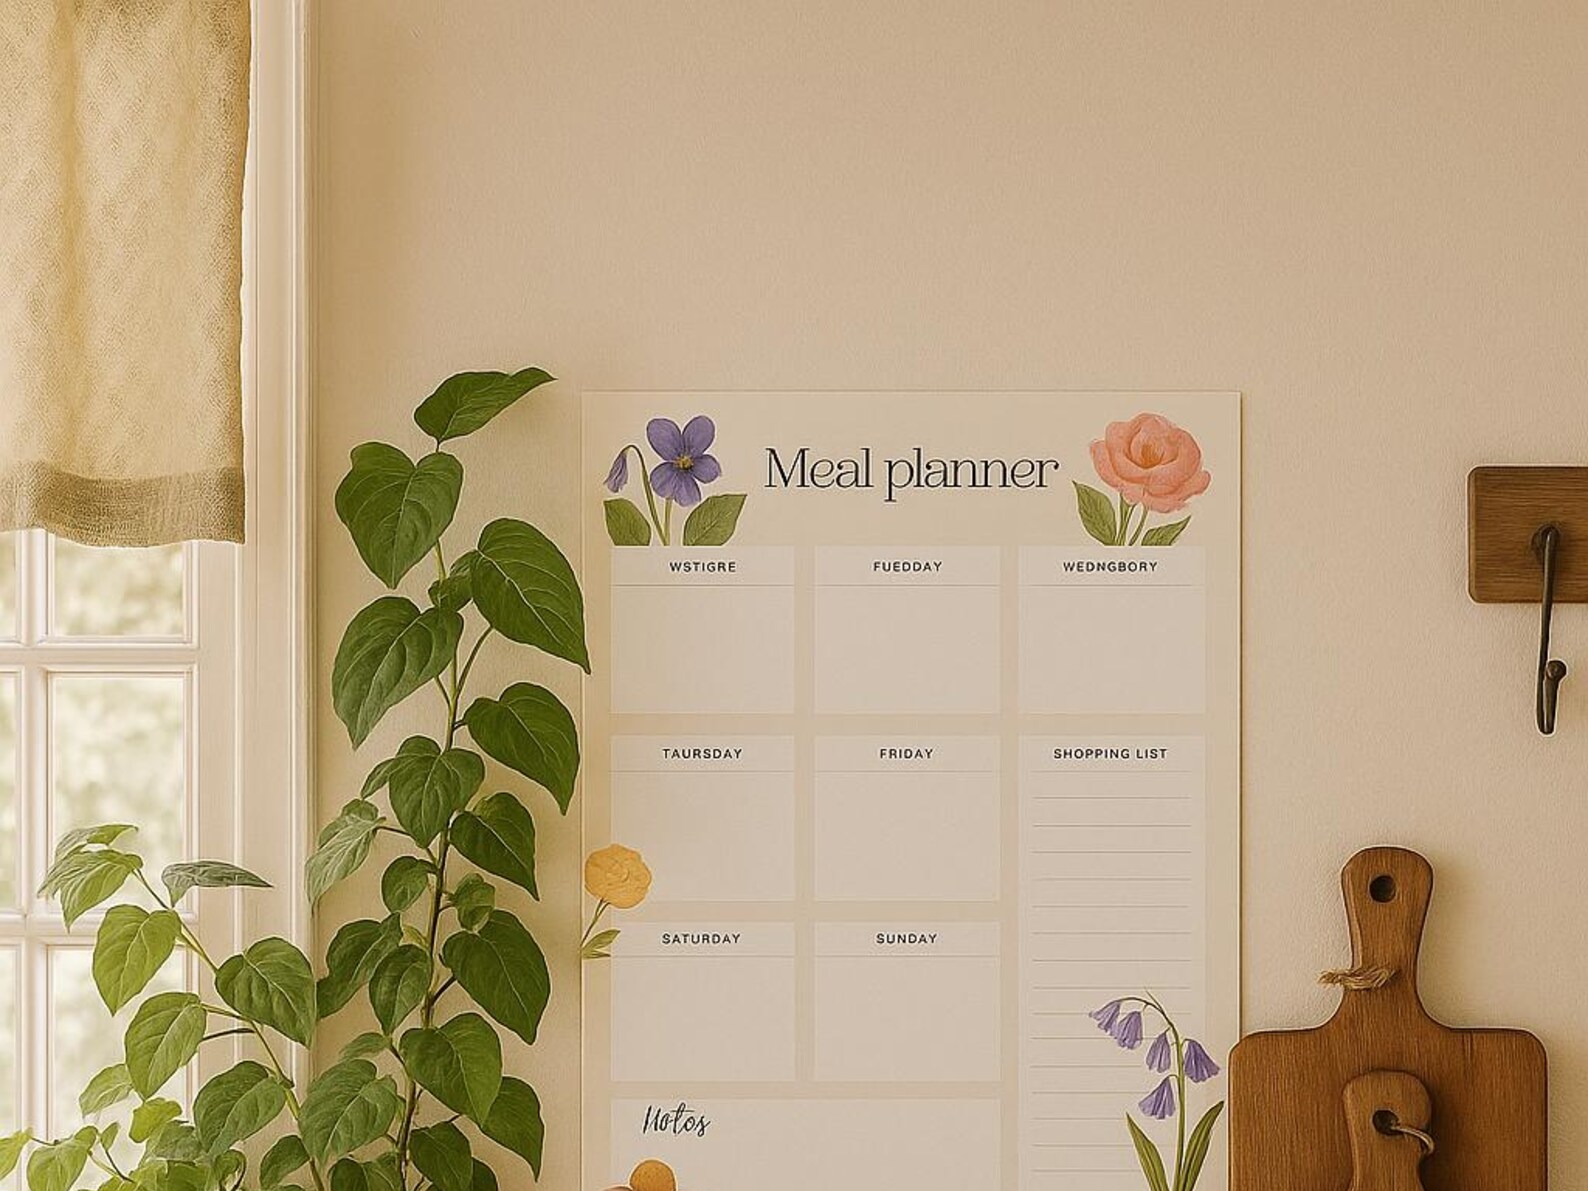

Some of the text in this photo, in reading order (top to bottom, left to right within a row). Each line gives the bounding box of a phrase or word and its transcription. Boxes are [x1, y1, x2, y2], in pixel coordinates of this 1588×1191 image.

[764, 447, 1060, 502] Meal planner
[669, 561, 736, 573] WSTIGRE
[873, 561, 943, 573] FUEDDAY
[662, 748, 743, 760] TAURSDAY
[879, 748, 934, 760] FRIDAY
[1053, 748, 1168, 760] SHOPPING LIST
[661, 932, 741, 945] SATURDAY
[876, 932, 938, 945] SUNDAY
